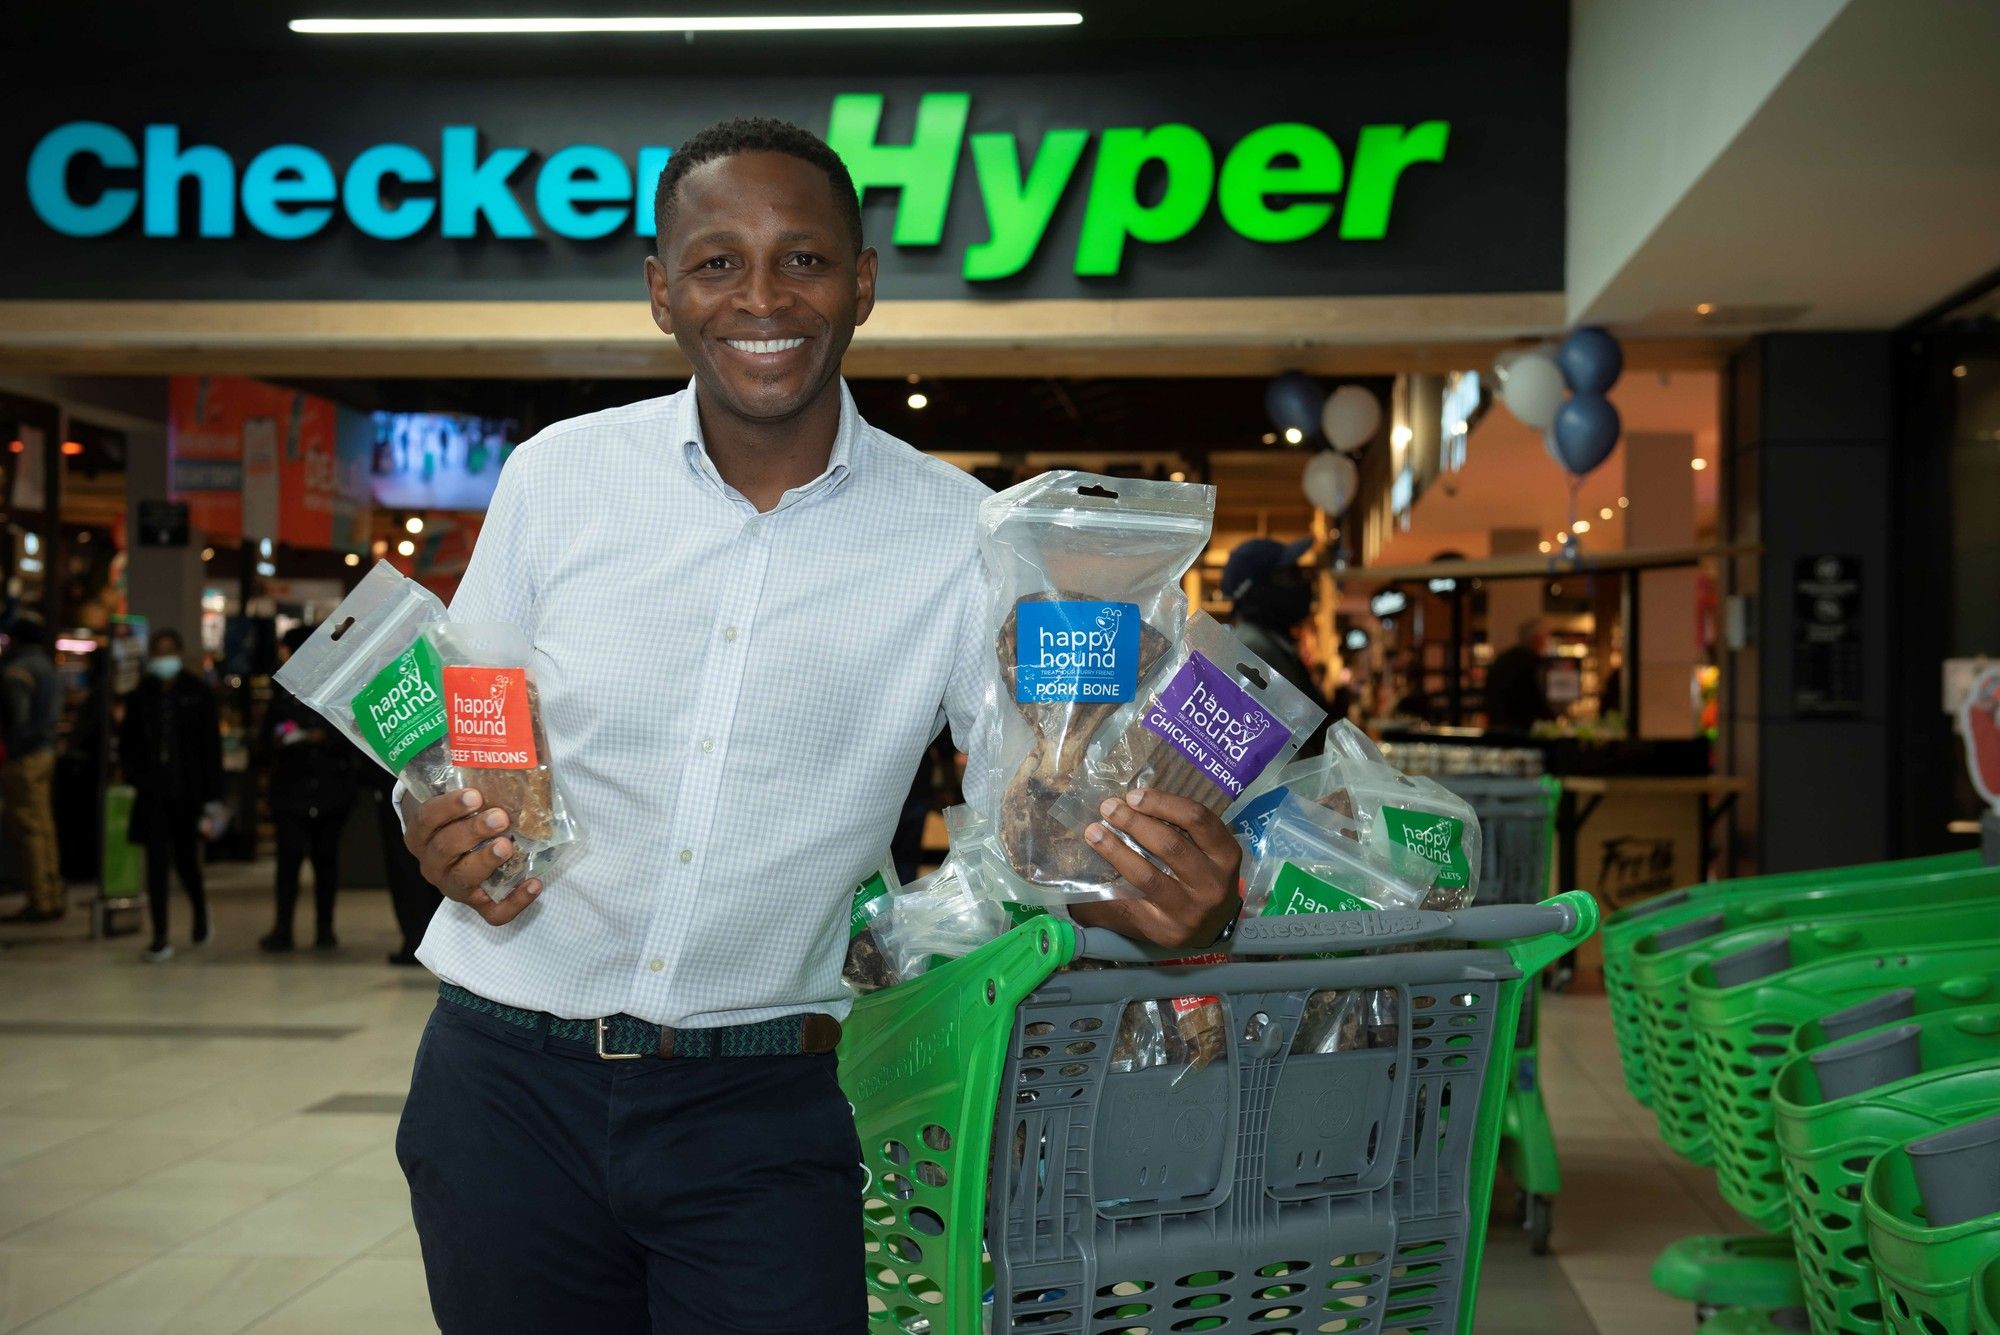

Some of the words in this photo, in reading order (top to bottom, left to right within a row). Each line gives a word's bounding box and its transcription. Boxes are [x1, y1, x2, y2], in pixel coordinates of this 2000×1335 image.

[826, 92, 1450, 281] Hyper
[1040, 626, 1116, 651] happy
[1040, 648, 1115, 668] hound
[369, 668, 422, 721] happy
[1036, 683, 1079, 696] PORK
[1083, 684, 1120, 696] BONE
[377, 681, 437, 739] hound
[454, 692, 505, 719] happy
[1192, 681, 1254, 745] happy
[454, 714, 506, 736] hound
[1177, 711, 1193, 727] TREAT
[1191, 725, 1207, 740] YOUR
[1181, 695, 1249, 762] hound
[388, 730, 420, 762] CHICKEN
[473, 751, 529, 764] TENDONS
[1150, 713, 1208, 763] CHICKEN
[1204, 758, 1245, 796] JERKY
[1402, 824, 1451, 851] happy
[1405, 837, 1452, 864] hound
